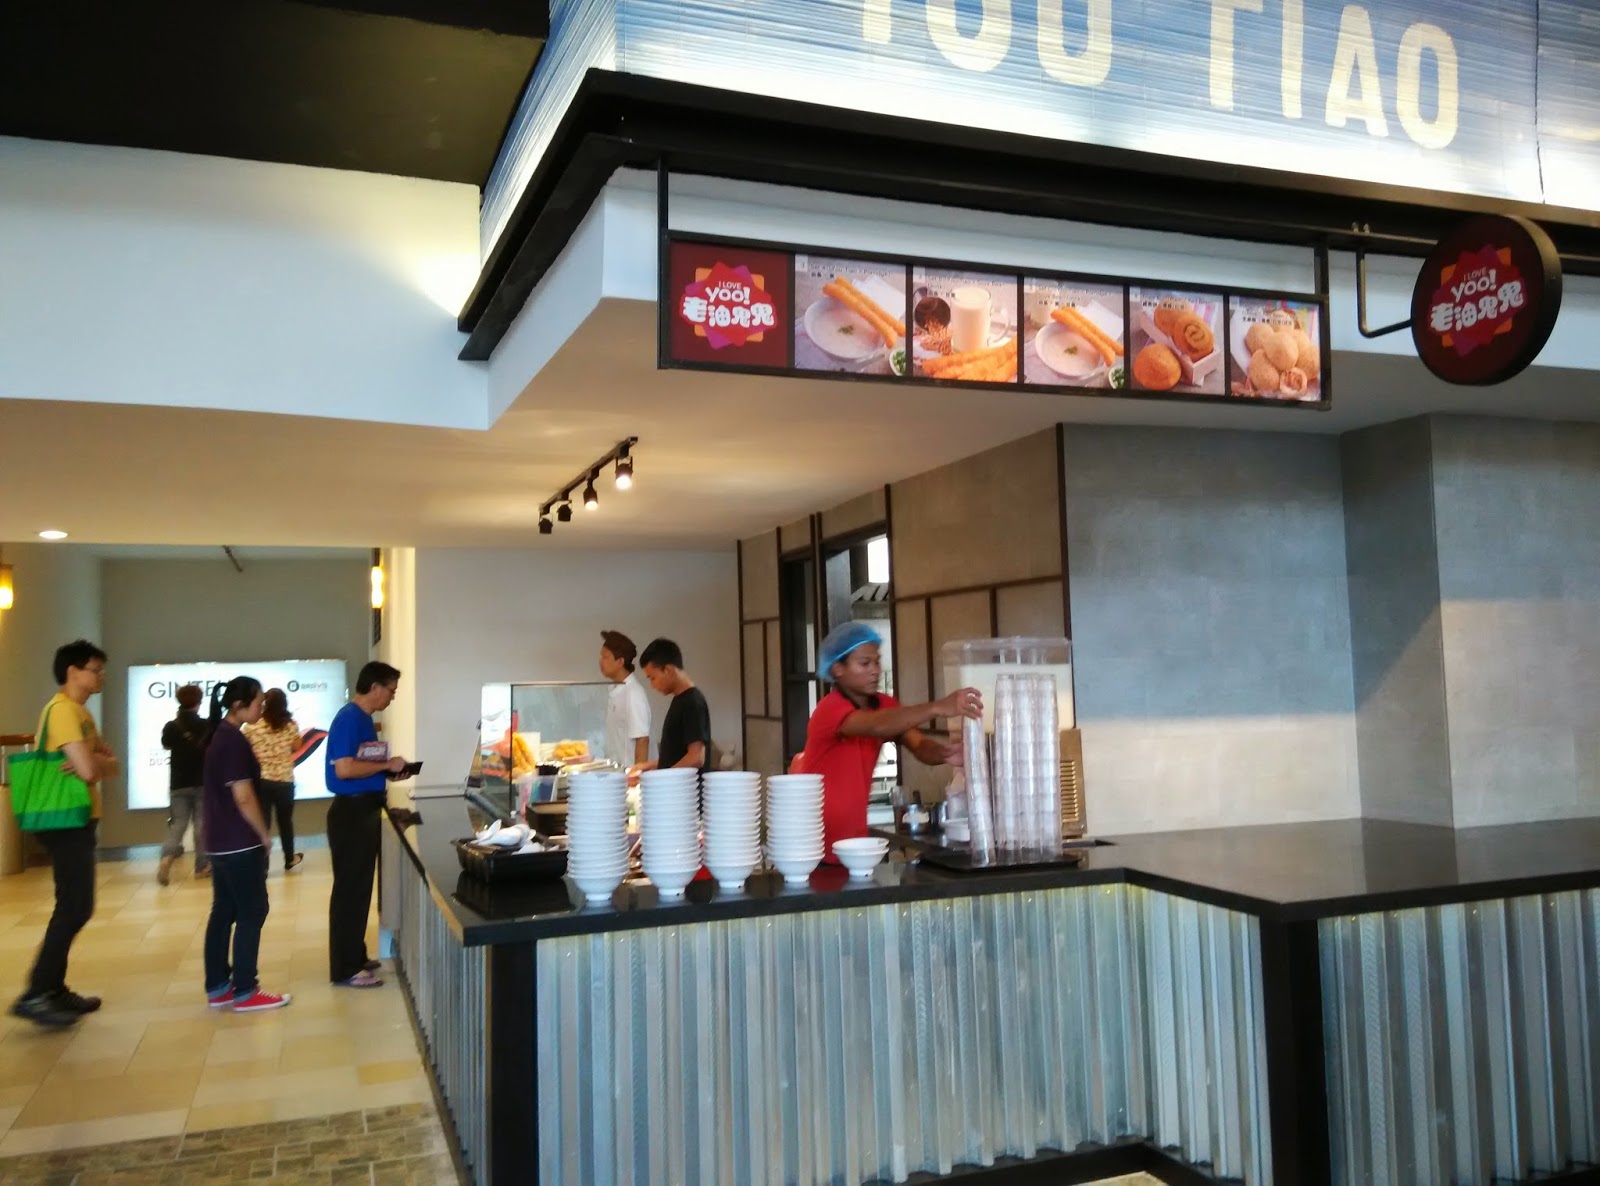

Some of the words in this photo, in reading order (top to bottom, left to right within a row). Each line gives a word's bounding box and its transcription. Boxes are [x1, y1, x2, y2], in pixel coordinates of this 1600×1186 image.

[1206, 0, 1458, 150] TIAO
[1467, 266, 1487, 280] LOVE
[722, 281, 742, 290] LOVE
